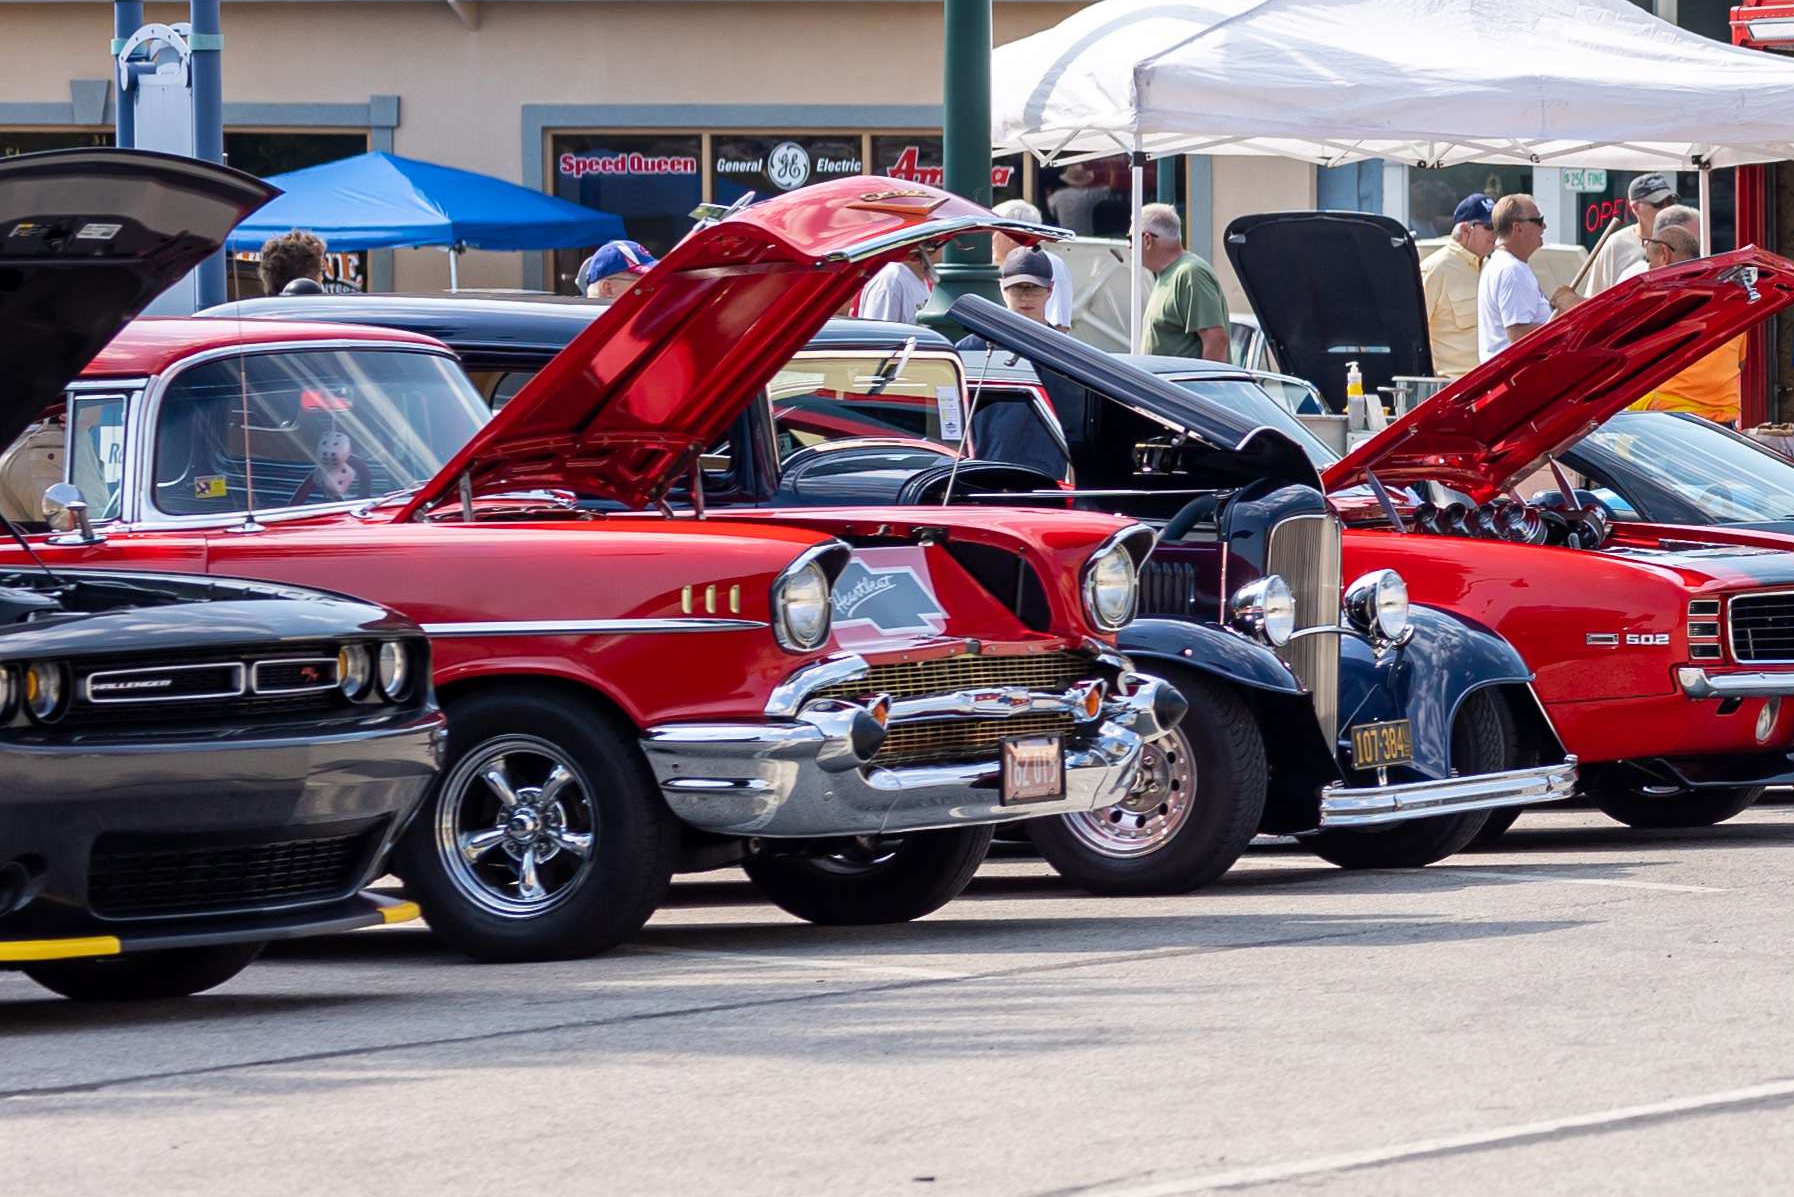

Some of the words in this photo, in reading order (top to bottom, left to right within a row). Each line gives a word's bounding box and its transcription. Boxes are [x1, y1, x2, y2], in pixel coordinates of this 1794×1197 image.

[560, 153, 627, 178] Speed
[629, 153, 697, 175] Queen
[717, 157, 763, 173] General
[816, 157, 862, 173] Electric
[1625, 633, 1670, 645] 502
